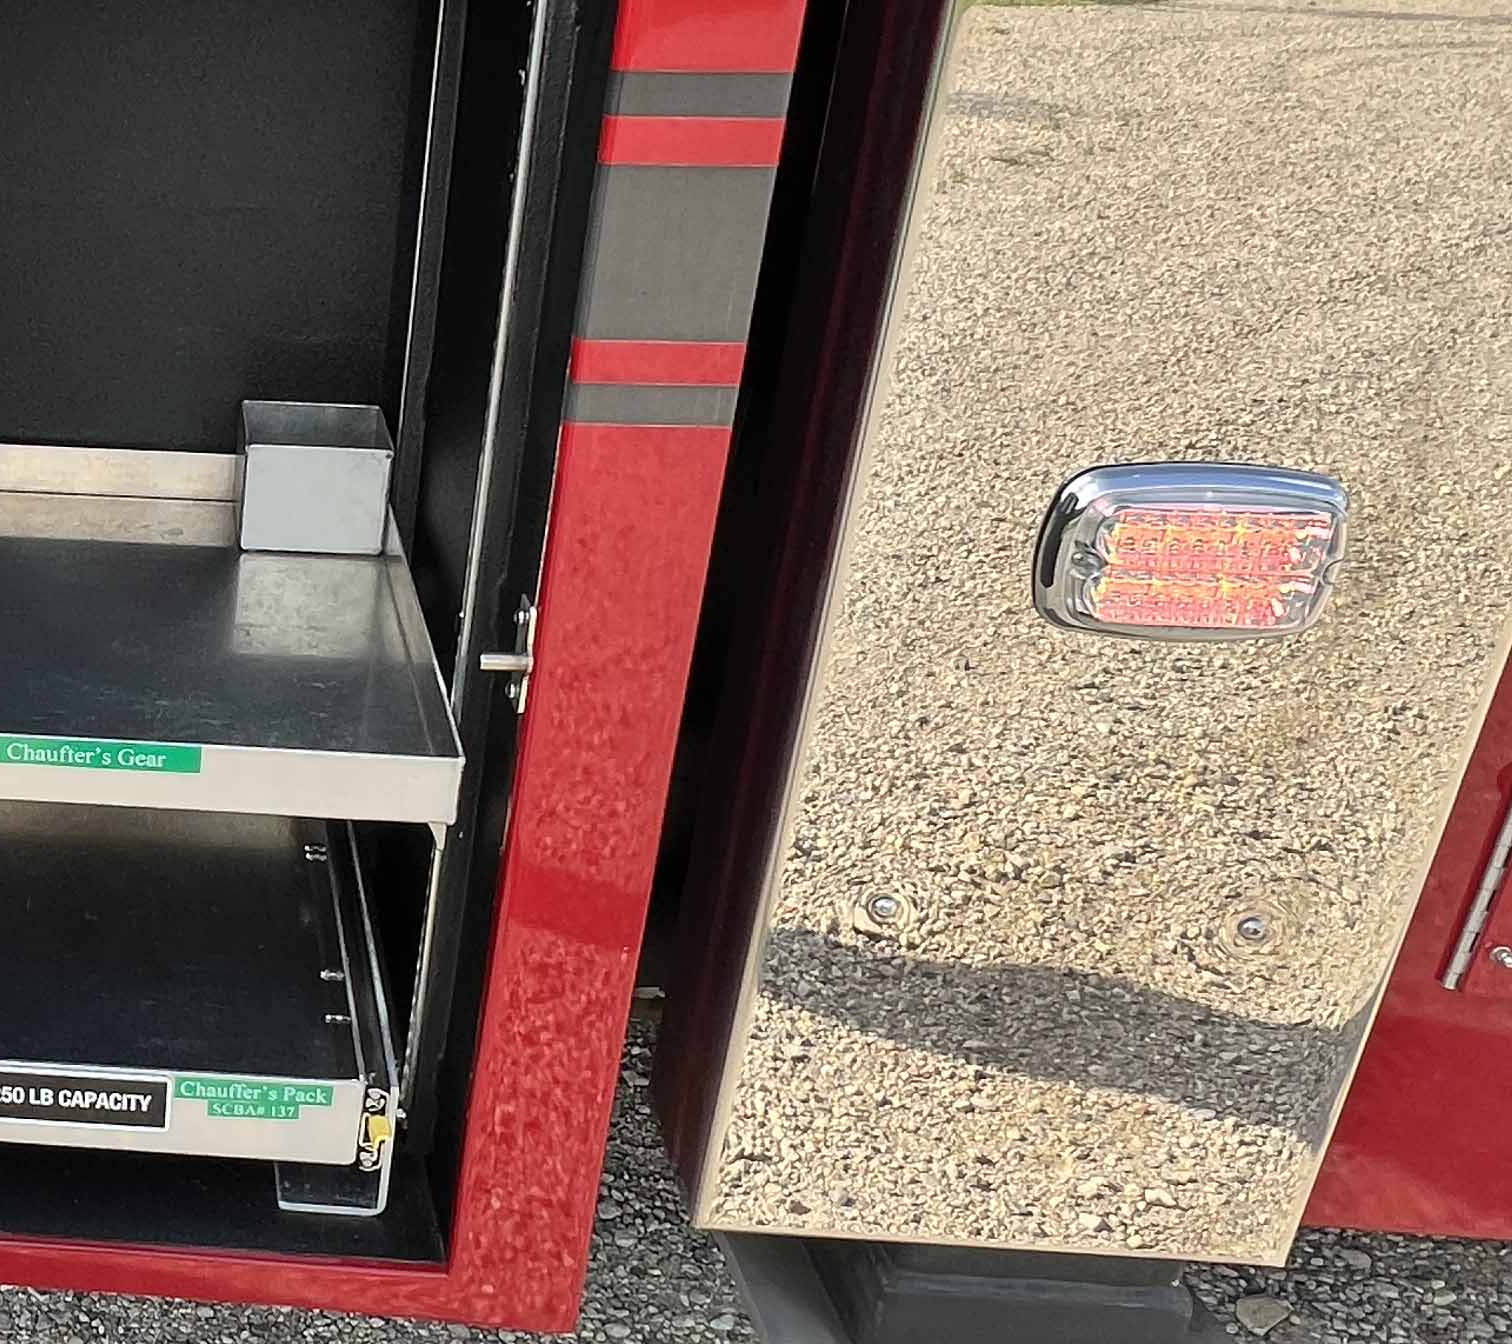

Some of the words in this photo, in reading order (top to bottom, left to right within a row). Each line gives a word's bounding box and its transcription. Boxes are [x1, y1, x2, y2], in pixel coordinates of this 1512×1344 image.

[6, 742, 112, 766] Chauffer's
[117, 748, 167, 768] Gear
[28, 1087, 55, 1108] LB
[57, 1088, 153, 1113] CAPACITY
[179, 1080, 278, 1102] Chauffer's
[283, 1087, 328, 1104] Pack
[211, 1103, 265, 1117] SCBA#
[271, 1104, 296, 1118] 137
